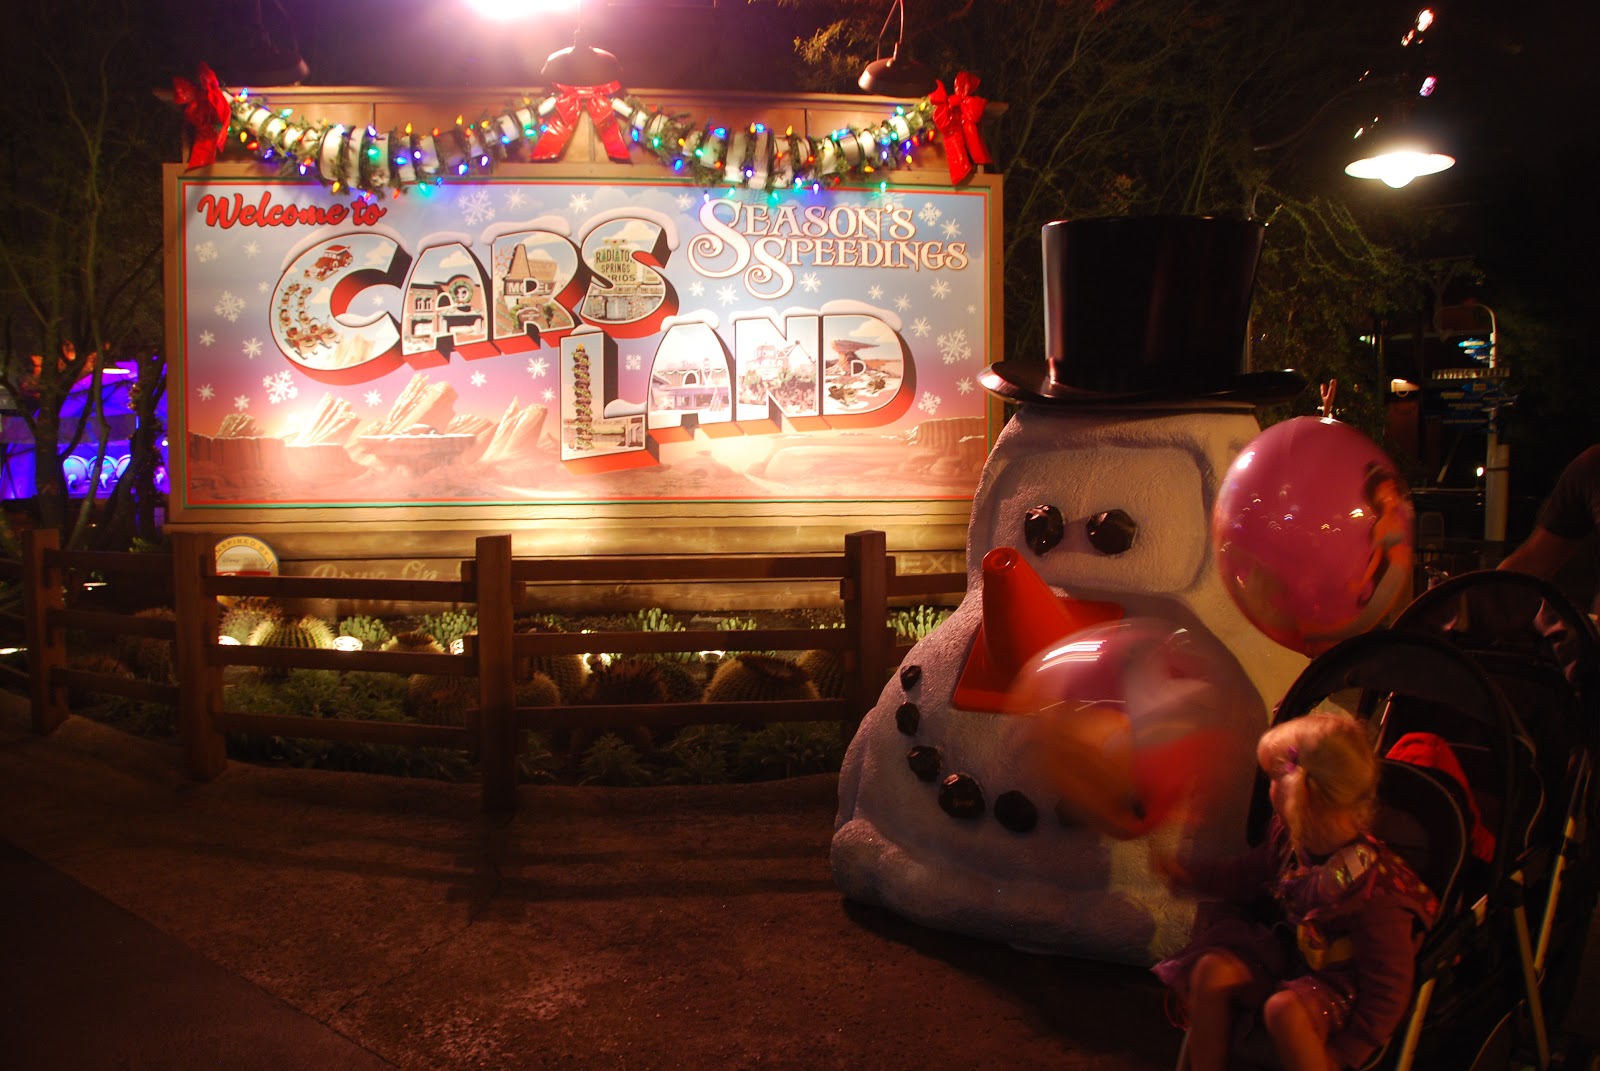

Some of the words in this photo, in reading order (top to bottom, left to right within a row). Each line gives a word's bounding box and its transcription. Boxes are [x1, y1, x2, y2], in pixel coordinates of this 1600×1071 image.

[197, 191, 350, 229] Welcome
[350, 195, 387, 226] to
[595, 247, 635, 264] RADIATO
[687, 198, 917, 278] SEASON'S
[508, 282, 551, 293] MEL
[600, 263, 631, 274] SPRINGS
[743, 236, 969, 300] SPEEDINGS
[269, 215, 679, 385] CARS
[560, 313, 918, 474] LAND
